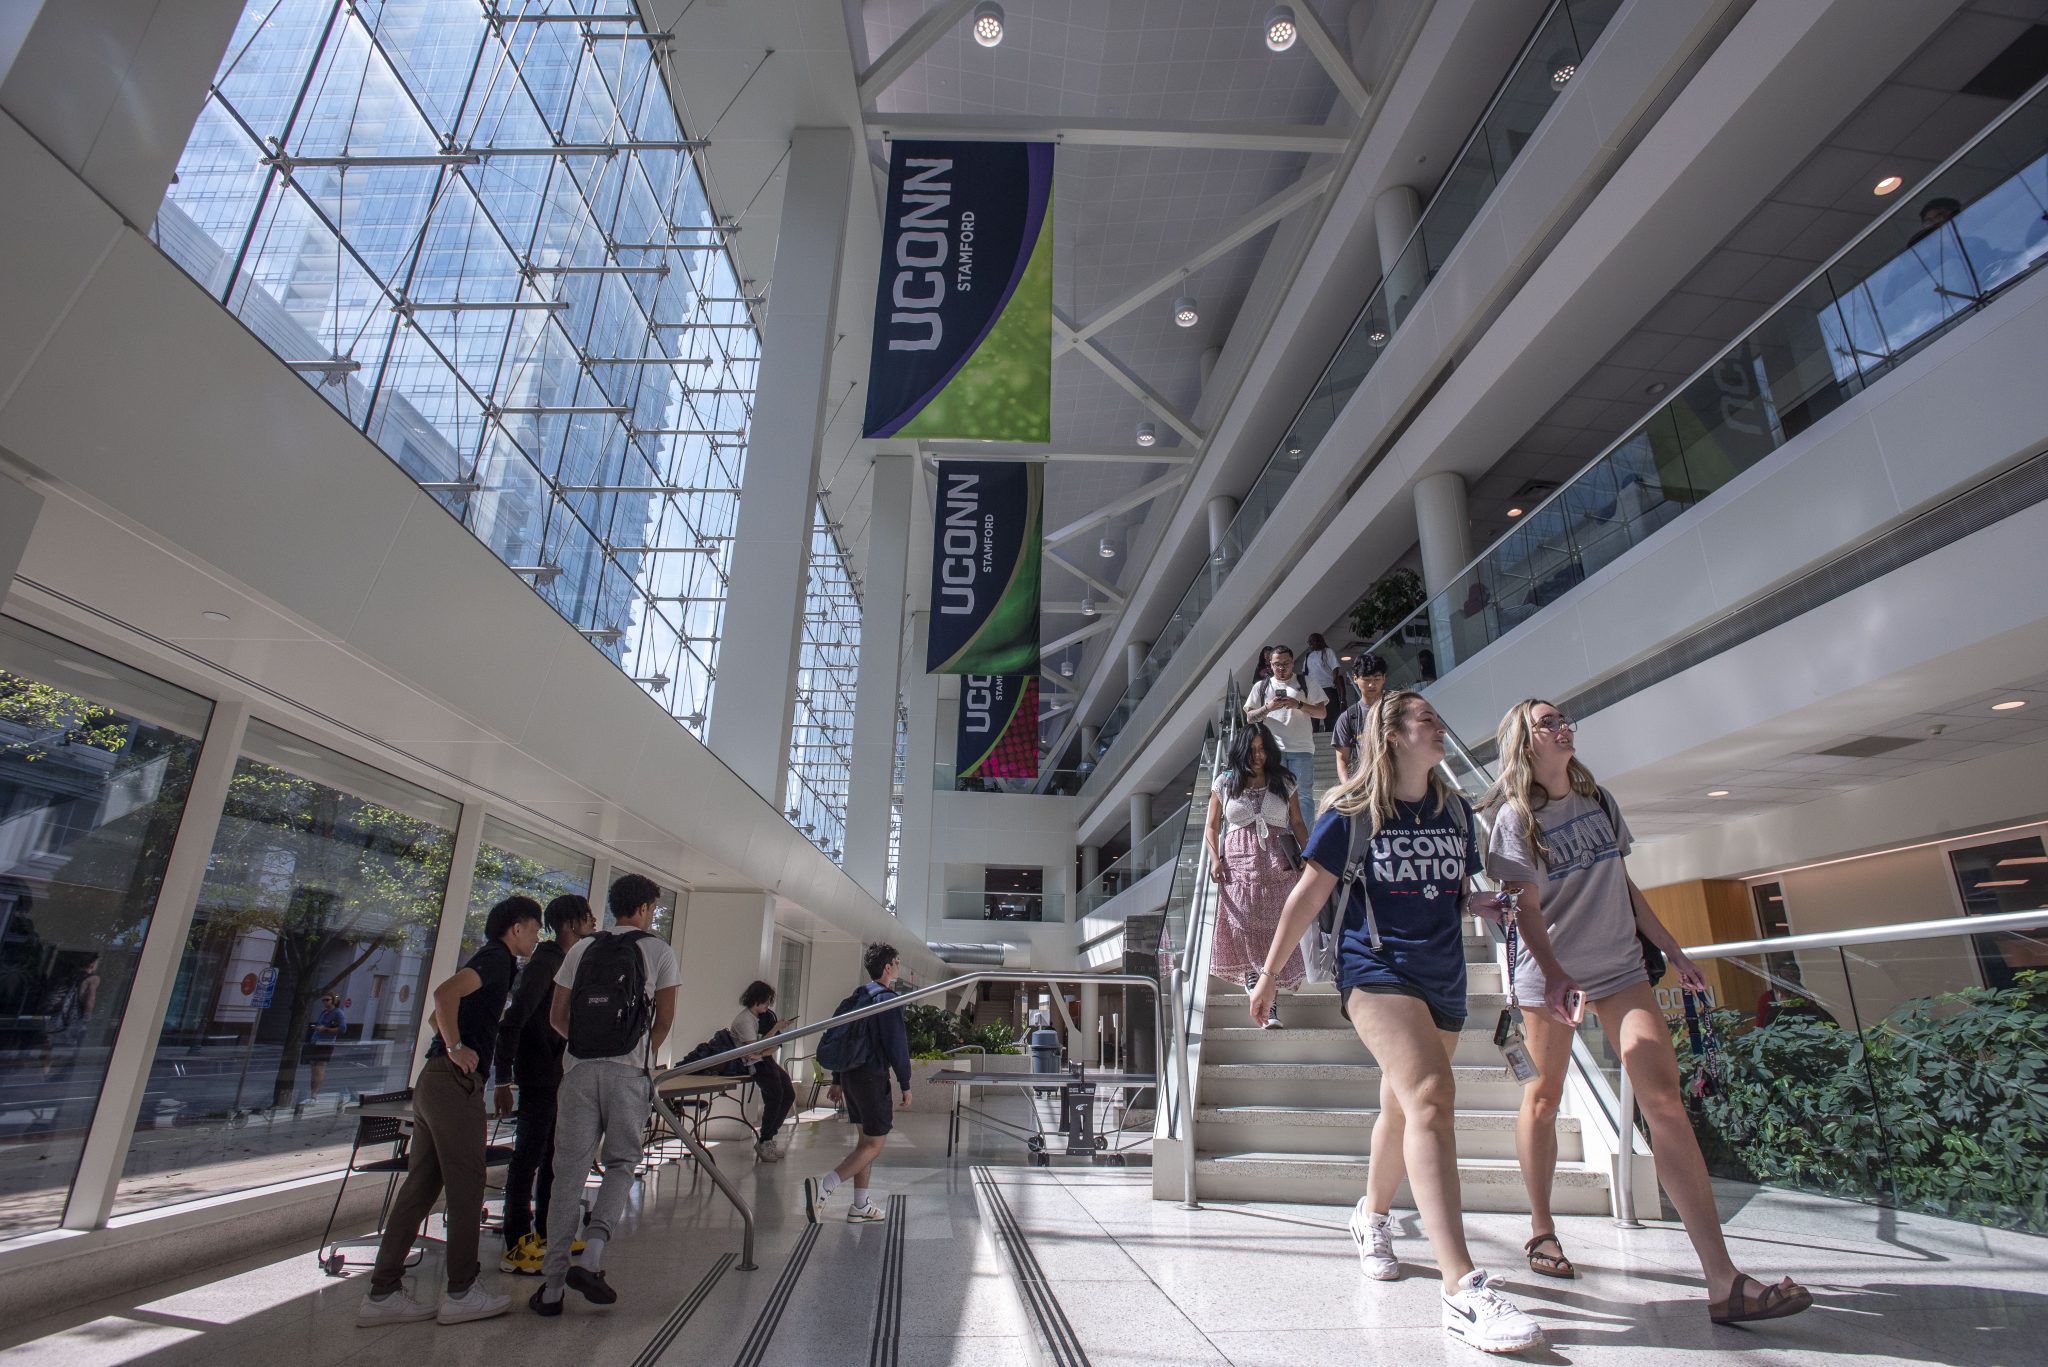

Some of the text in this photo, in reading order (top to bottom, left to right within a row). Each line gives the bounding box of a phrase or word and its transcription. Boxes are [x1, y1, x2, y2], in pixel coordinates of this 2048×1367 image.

[888, 158, 953, 350] UCONN
[957, 211, 975, 292] STAMFORD
[941, 473, 980, 615] UCONN
[983, 513, 994, 573] STAMFORD
[966, 674, 992, 733] UCO
[1370, 836, 1467, 860] UCONN
[1413, 828, 1447, 836] MEMBER
[1508, 940, 1516, 968] UCONN
